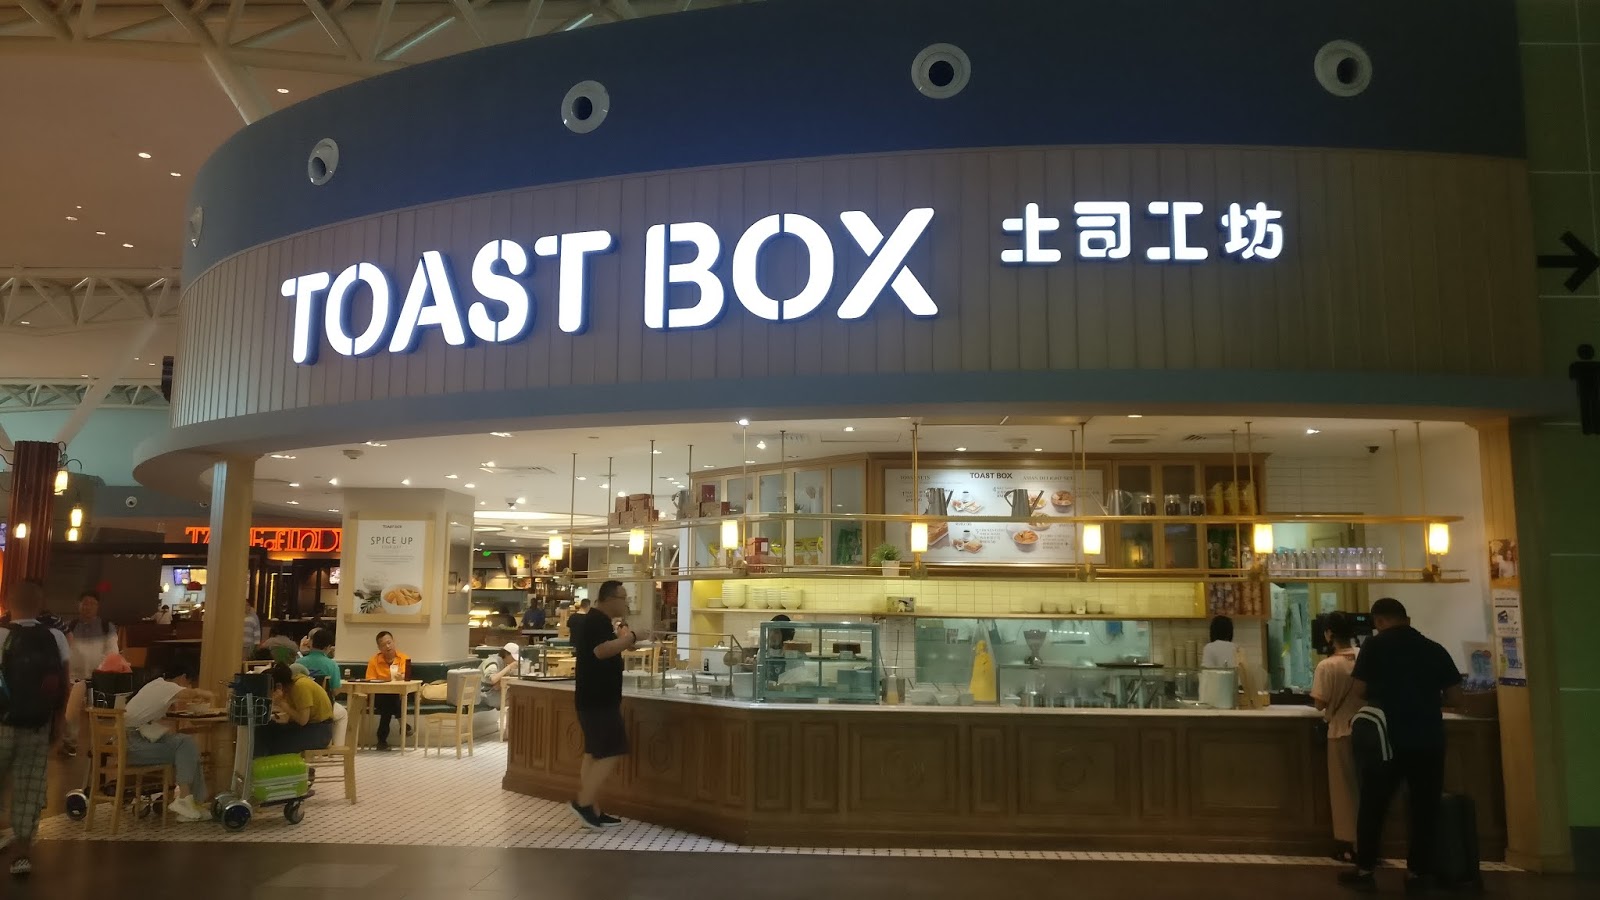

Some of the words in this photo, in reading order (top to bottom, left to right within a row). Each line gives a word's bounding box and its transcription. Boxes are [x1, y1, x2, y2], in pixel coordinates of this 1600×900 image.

[1001, 201, 1283, 263] 土司工坊
[281, 230, 612, 364] TOAST
[644, 207, 938, 329] BOX
[371, 536, 397, 545] SPICE
[400, 536, 413, 545] UP
